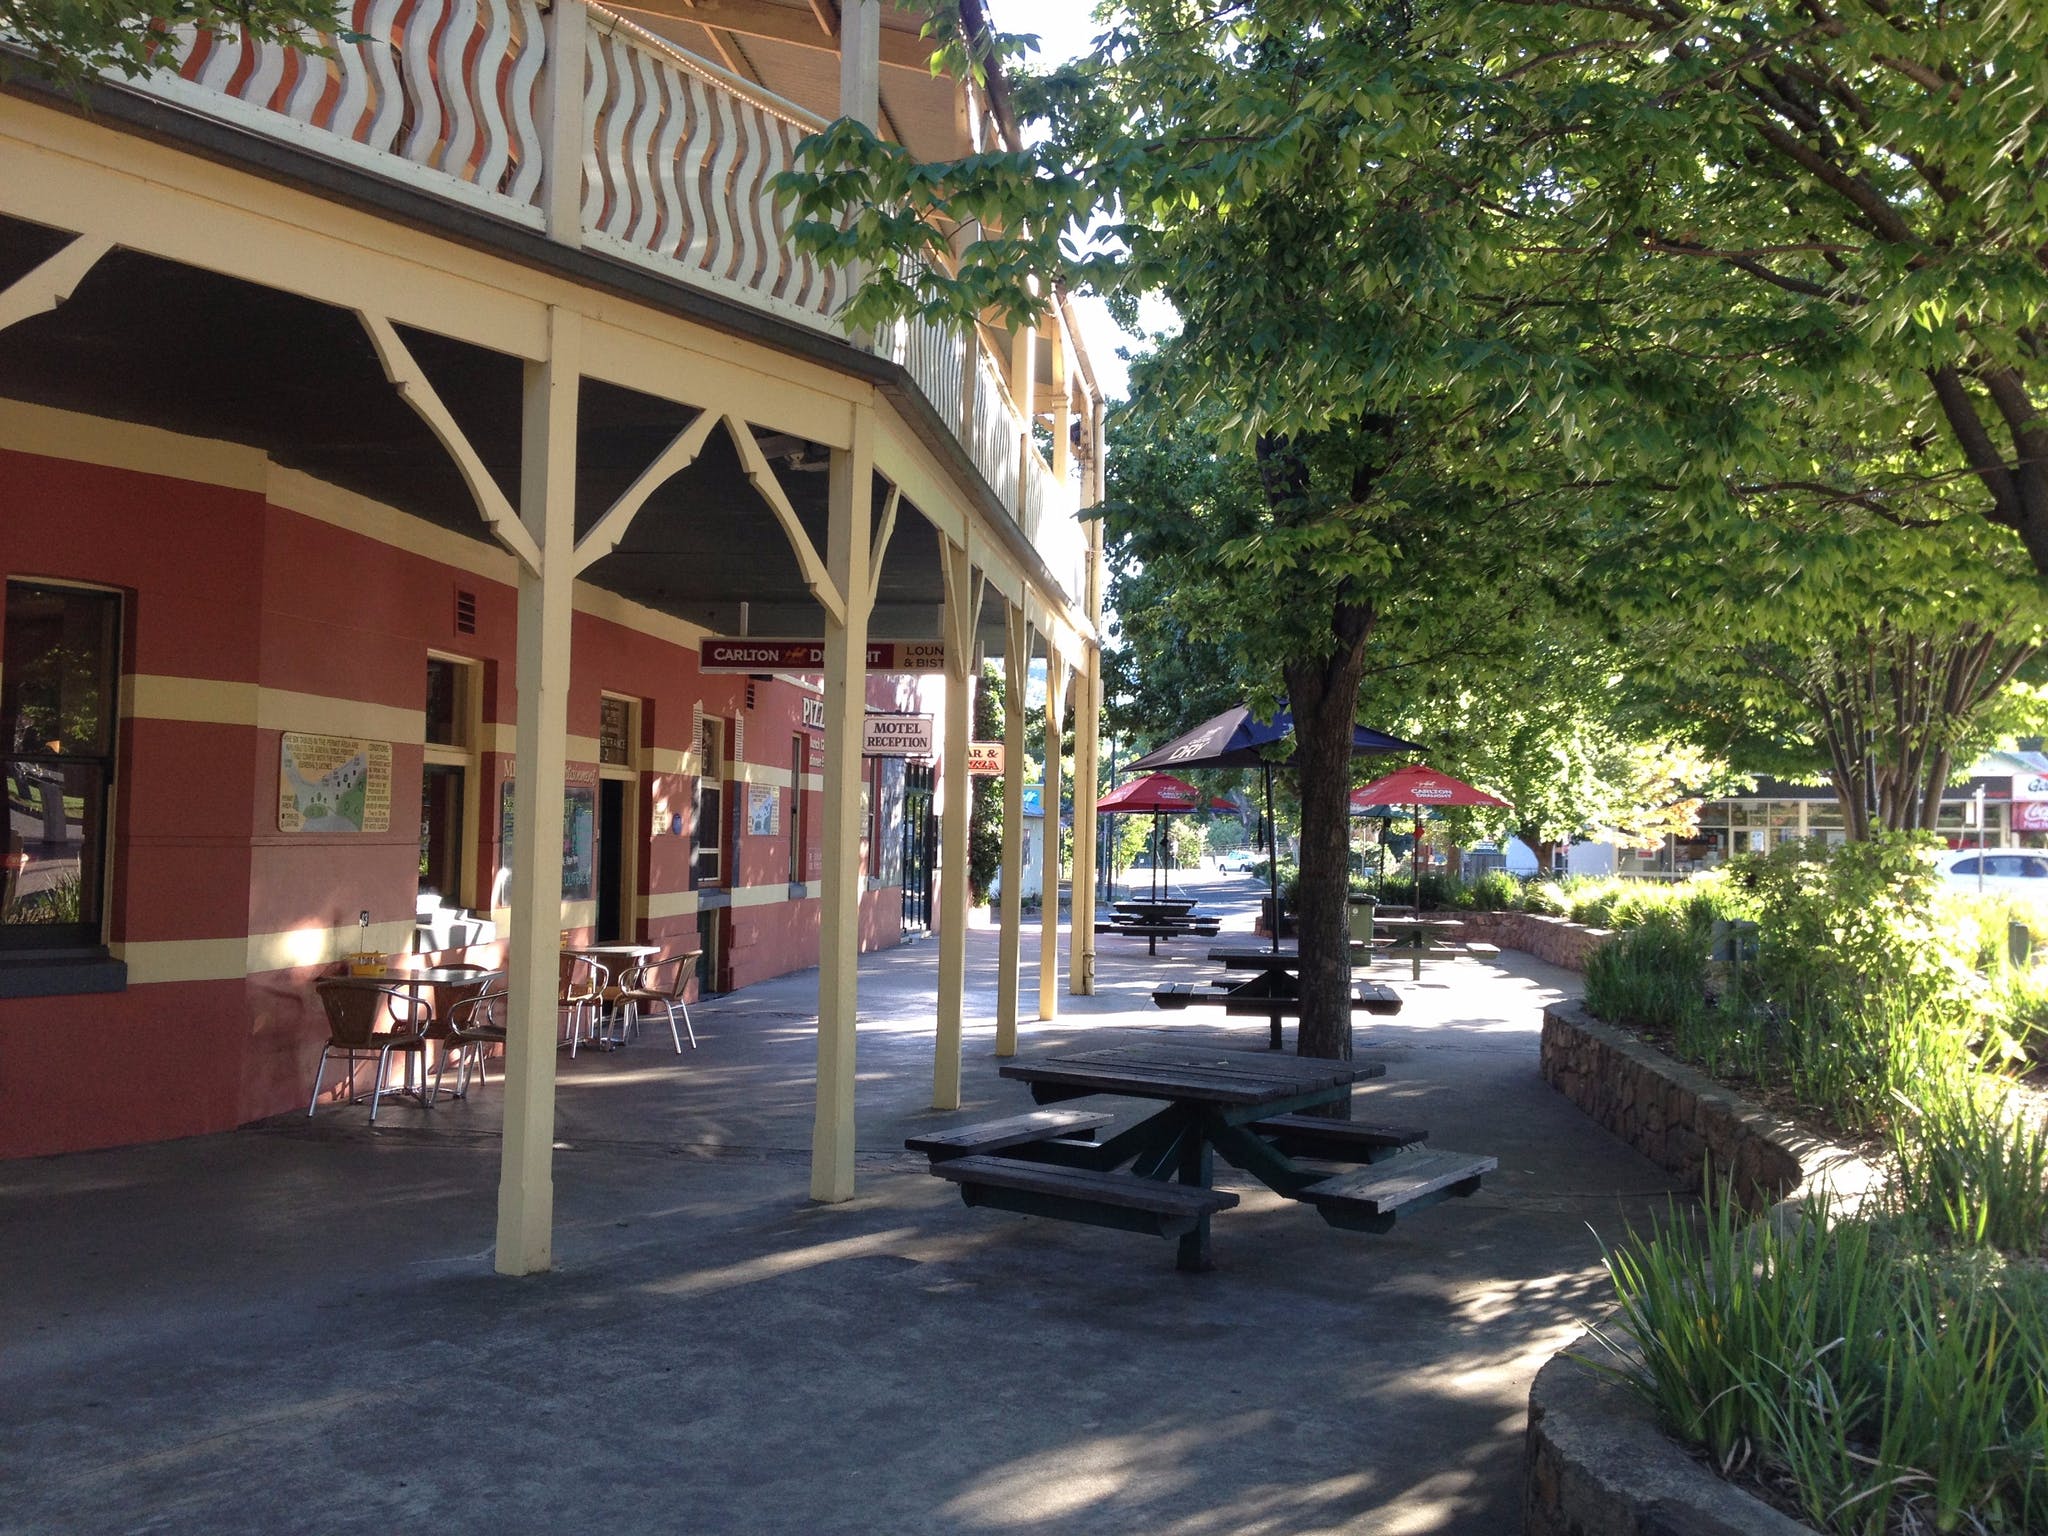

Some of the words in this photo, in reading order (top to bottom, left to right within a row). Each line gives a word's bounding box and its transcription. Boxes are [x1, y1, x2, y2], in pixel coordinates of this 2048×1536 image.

[713, 648, 779, 662] CARLTON
[906, 646, 944, 656] LOUN
[903, 659, 913, 668] &
[916, 659, 944, 668] BIST
[803, 697, 825, 729] PIZZ
[873, 723, 922, 734] MOTEL
[867, 737, 928, 748] RECEPTION
[987, 749, 998, 759] &
[1167, 741, 1210, 761] DRY
